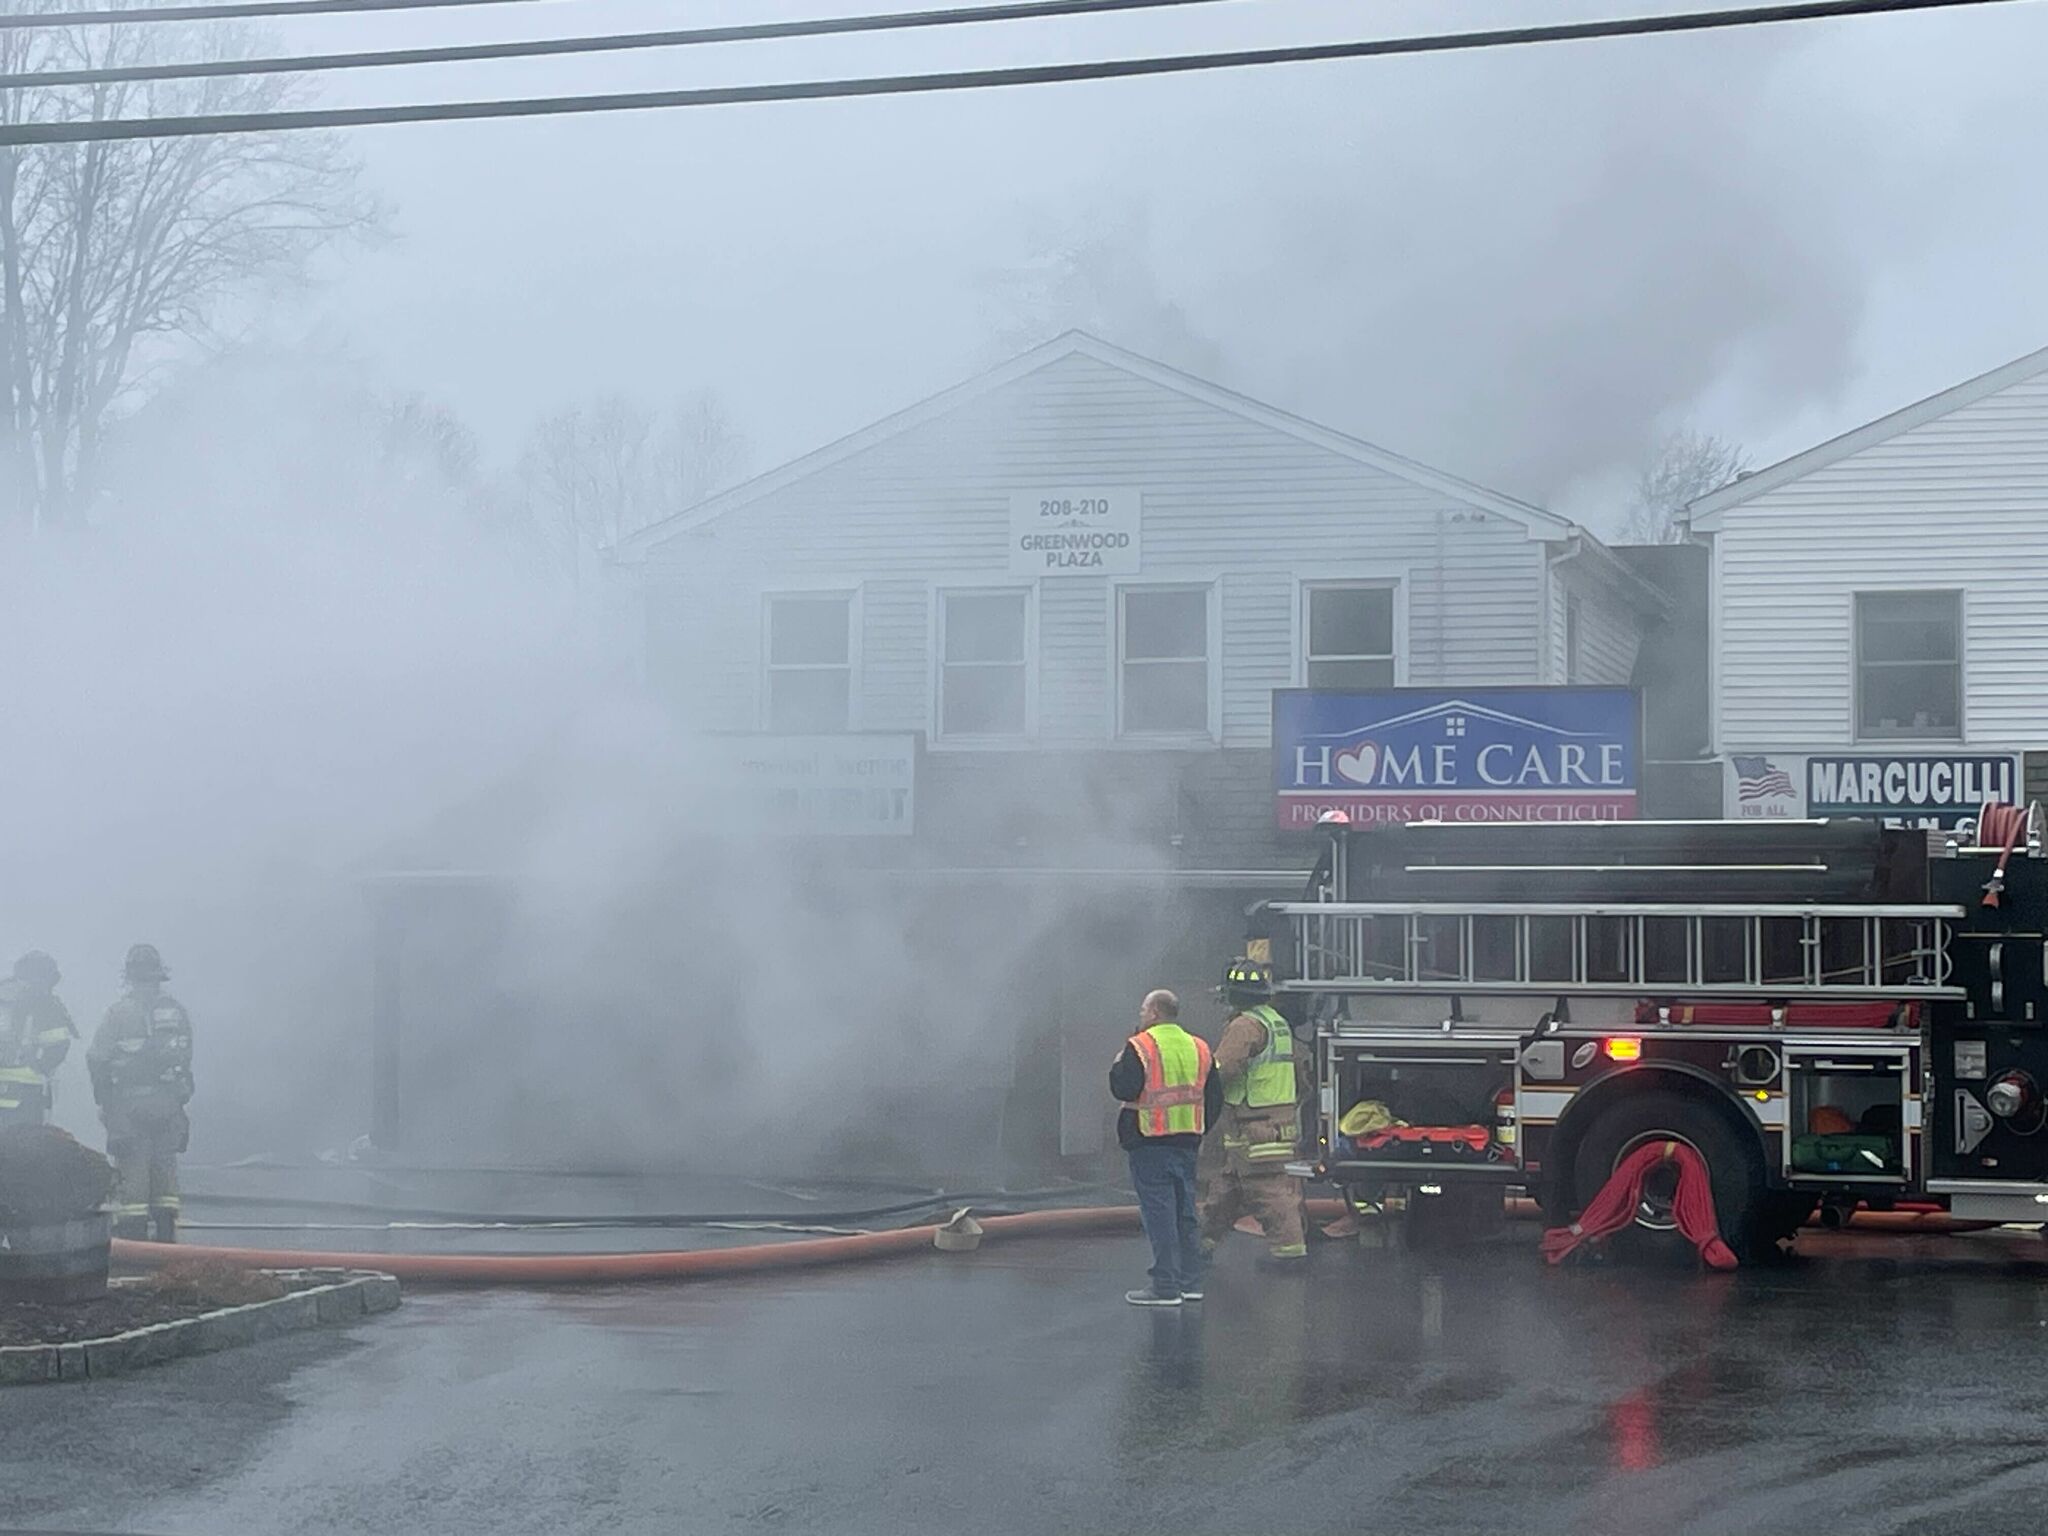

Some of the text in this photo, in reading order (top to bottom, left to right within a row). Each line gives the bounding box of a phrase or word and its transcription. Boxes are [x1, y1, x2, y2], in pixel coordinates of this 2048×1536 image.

[1040, 499, 1109, 516] 208-210
[1020, 533, 1130, 551] GREENWOOD
[1046, 551, 1103, 568] PLAZA
[1476, 744, 1625, 785] CARE
[1812, 762, 2009, 804] MARCUCILLI
[1292, 804, 1624, 821] PROIDERS OF CONNECTICUT
